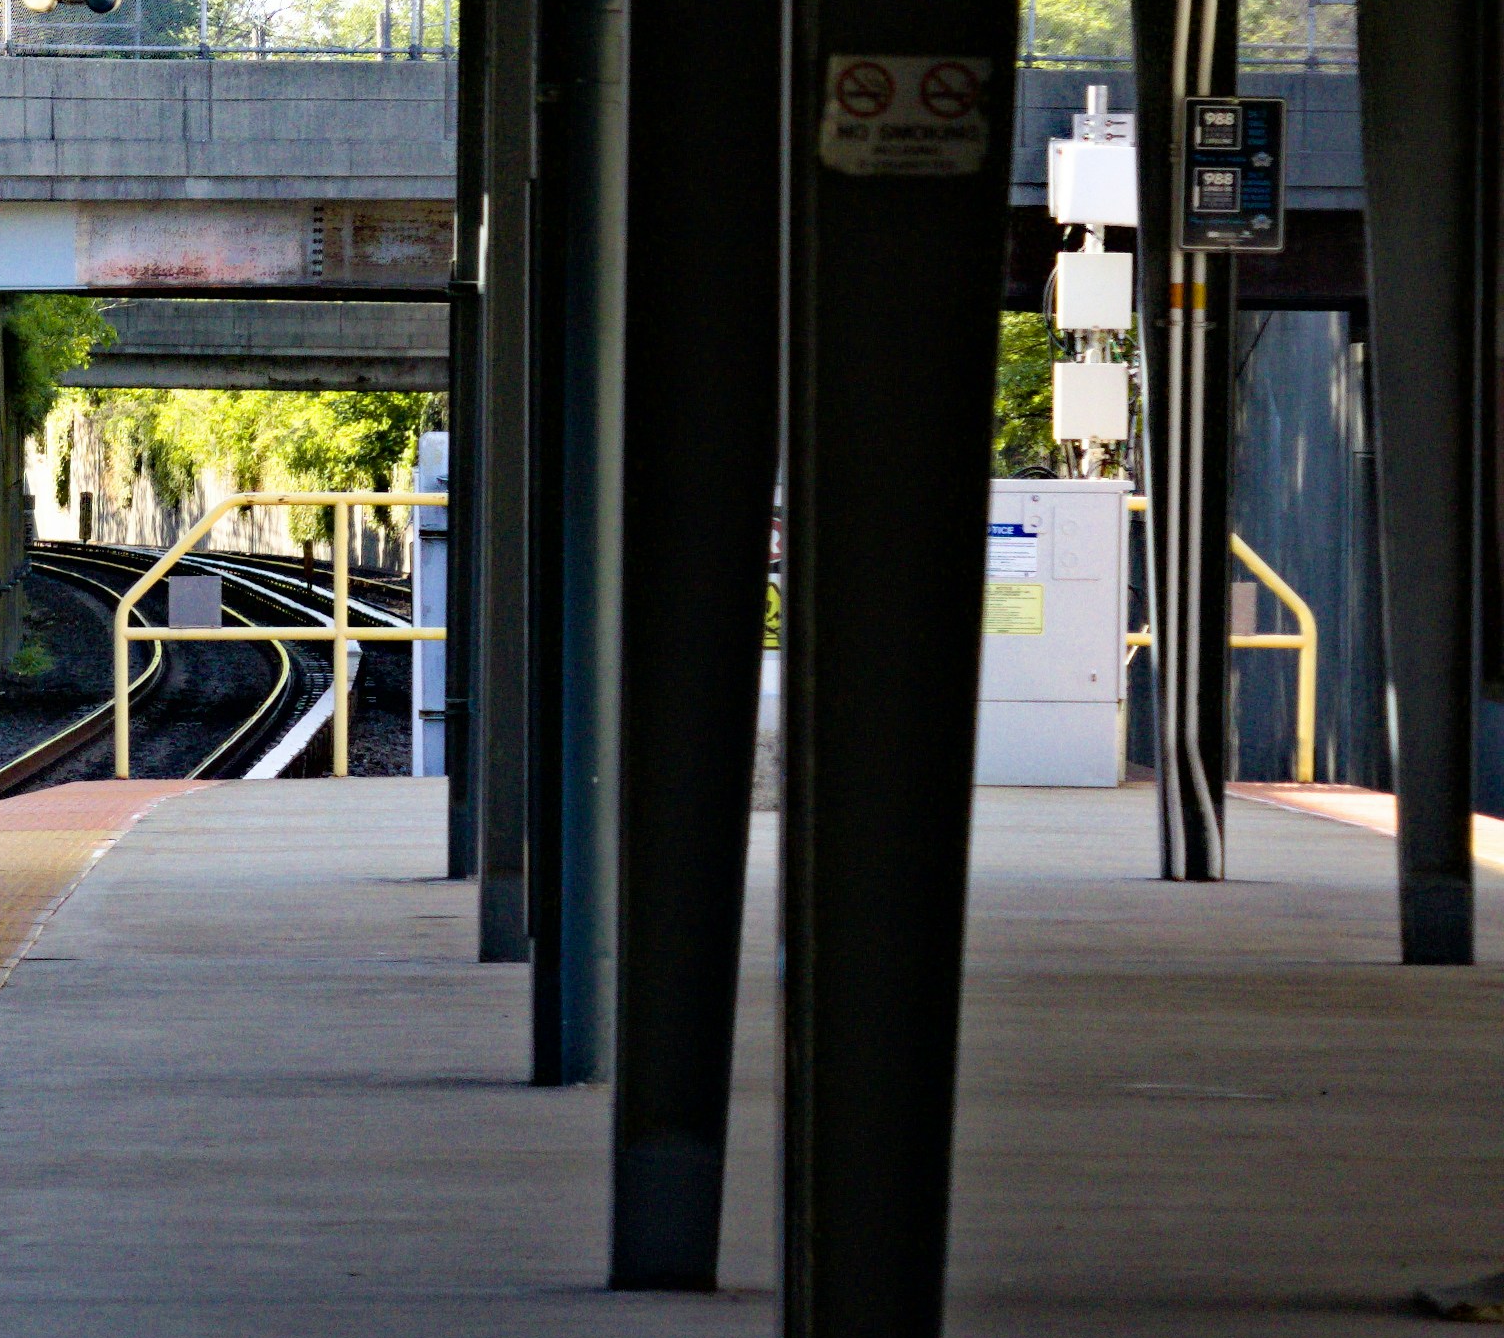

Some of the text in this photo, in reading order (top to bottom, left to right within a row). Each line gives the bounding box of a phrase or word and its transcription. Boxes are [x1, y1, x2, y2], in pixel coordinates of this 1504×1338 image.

[1203, 111, 1235, 125] 988
[837, 123, 981, 140] NO SMOKING
[1202, 172, 1234, 185] 988
[990, 526, 1014, 535] TICE
